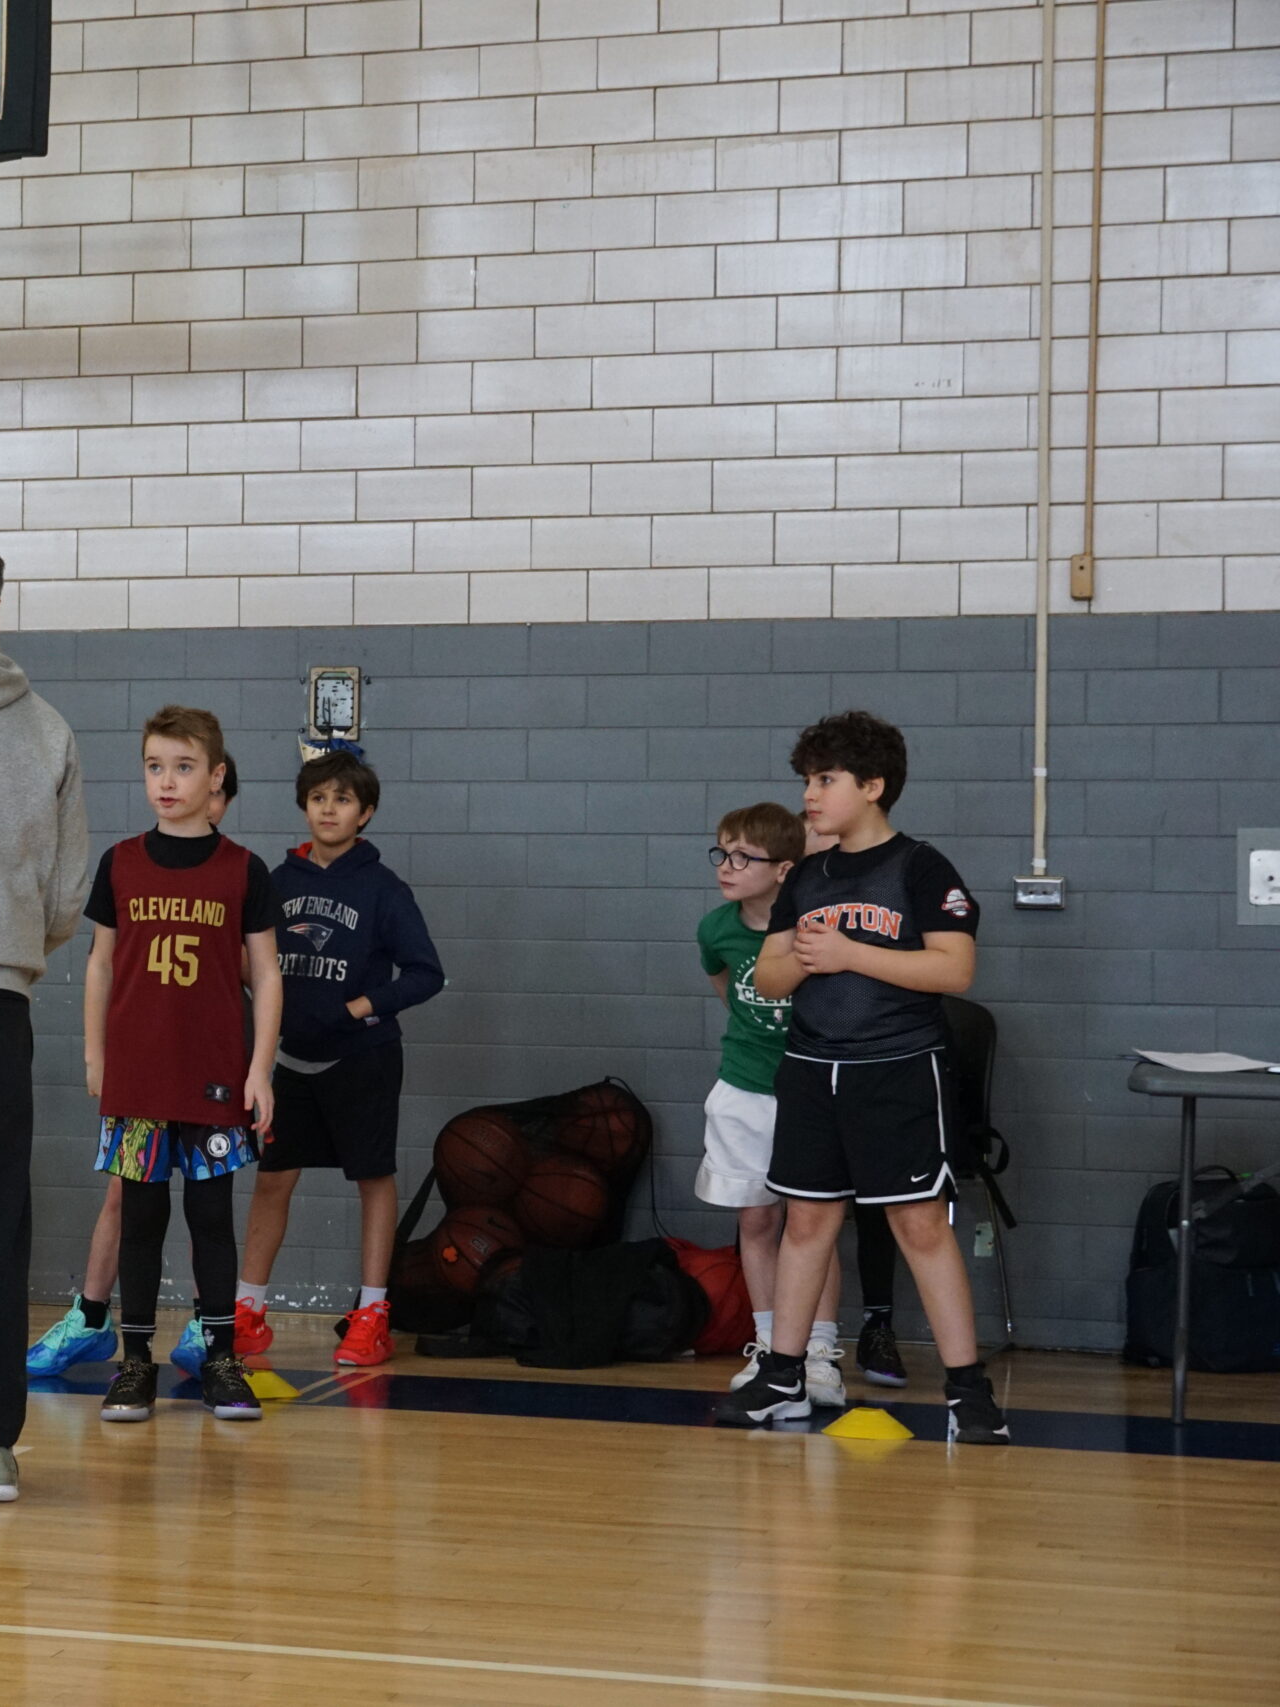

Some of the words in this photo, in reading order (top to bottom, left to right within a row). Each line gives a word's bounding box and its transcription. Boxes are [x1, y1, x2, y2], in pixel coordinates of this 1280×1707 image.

[129, 896, 226, 928] CLEVELAND
[305, 895, 360, 931] ENGLAND
[147, 933, 201, 987] 45
